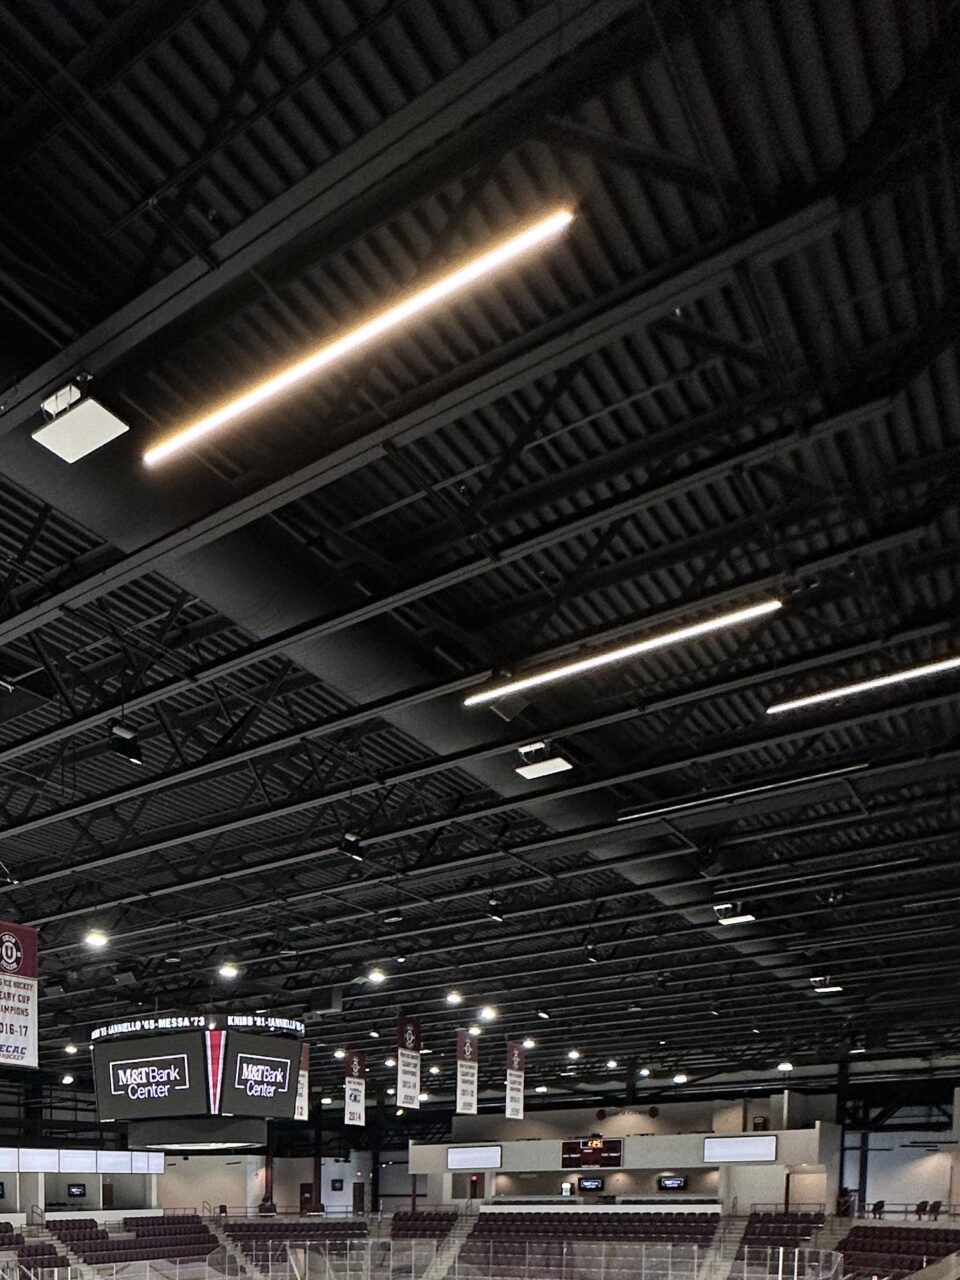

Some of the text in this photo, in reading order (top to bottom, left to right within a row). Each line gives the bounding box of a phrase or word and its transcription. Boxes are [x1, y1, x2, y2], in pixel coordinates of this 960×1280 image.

[4, 979, 12, 987] ICE
[14, 981, 34, 992] HOCKEY
[17, 994, 30, 1005] CUP
[192, 1016, 206, 1027] '73
[0, 1044, 27, 1055] ECAC
[118, 1064, 181, 1086] M&T Bank
[242, 1063, 284, 1083] M&T Bank
[128, 1083, 170, 1100] Center
[246, 1080, 276, 1097] Center
